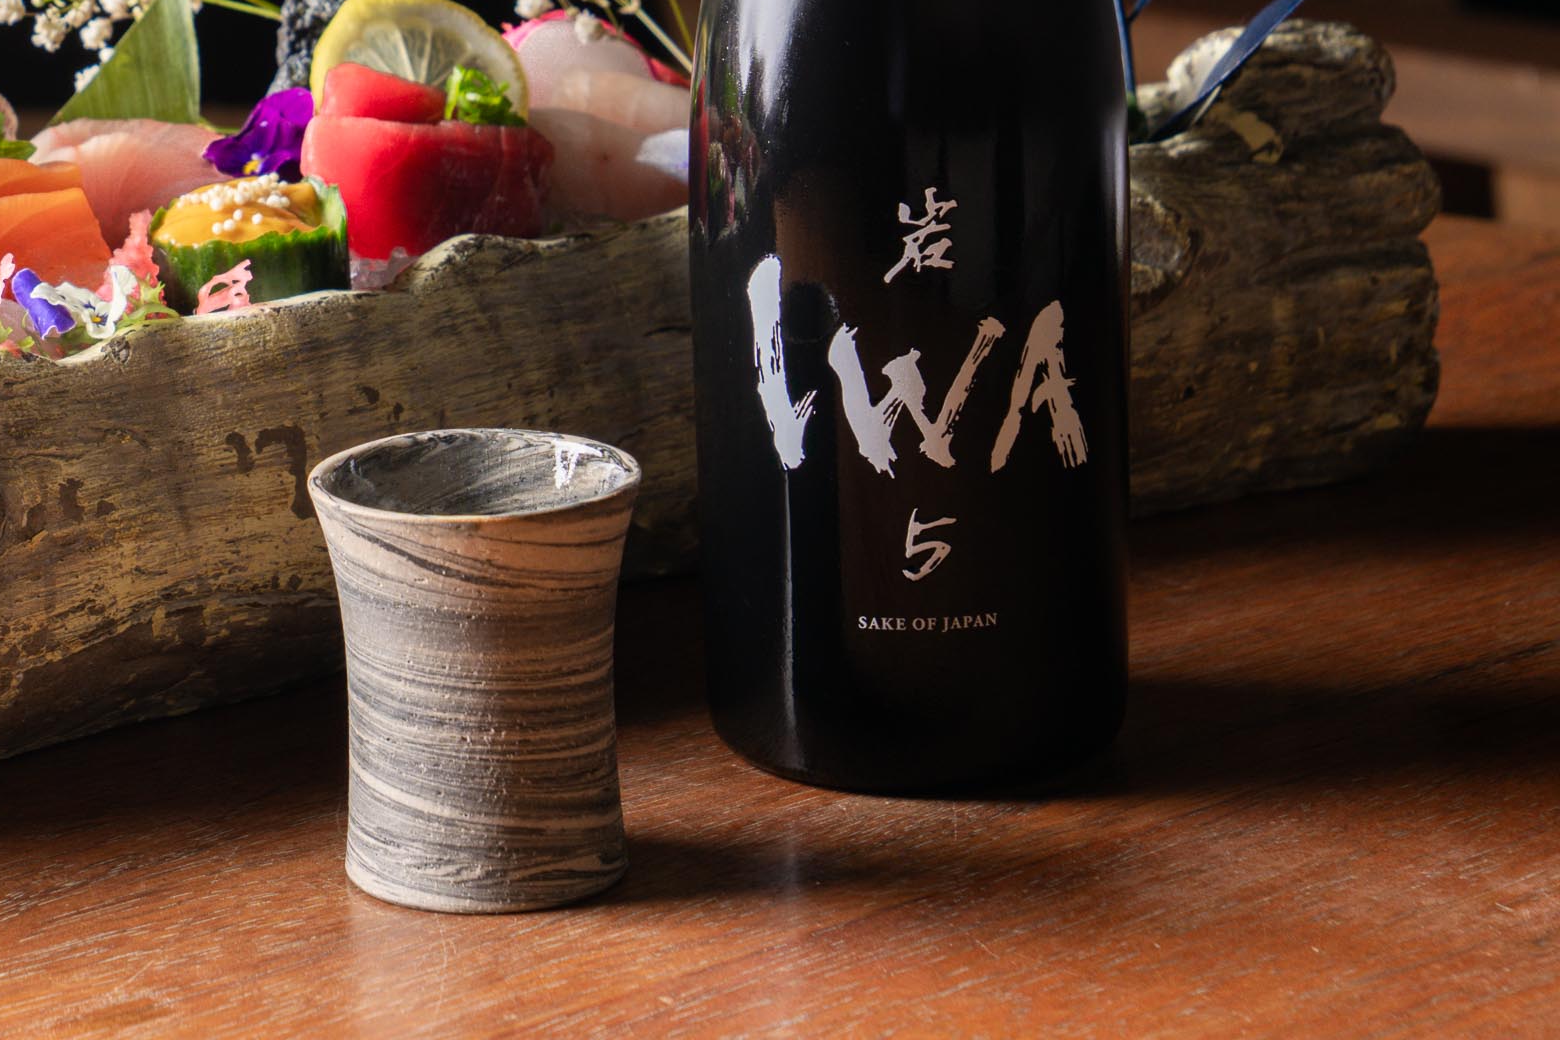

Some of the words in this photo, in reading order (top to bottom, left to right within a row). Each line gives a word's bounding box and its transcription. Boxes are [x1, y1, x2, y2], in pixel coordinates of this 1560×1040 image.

[883, 186, 958, 284] 岩
[747, 253, 1089, 479] IWA
[902, 508, 957, 581] 5
[857, 615, 907, 631] SAKE
[911, 616, 938, 631] OF
[942, 612, 998, 632] JAPAN
